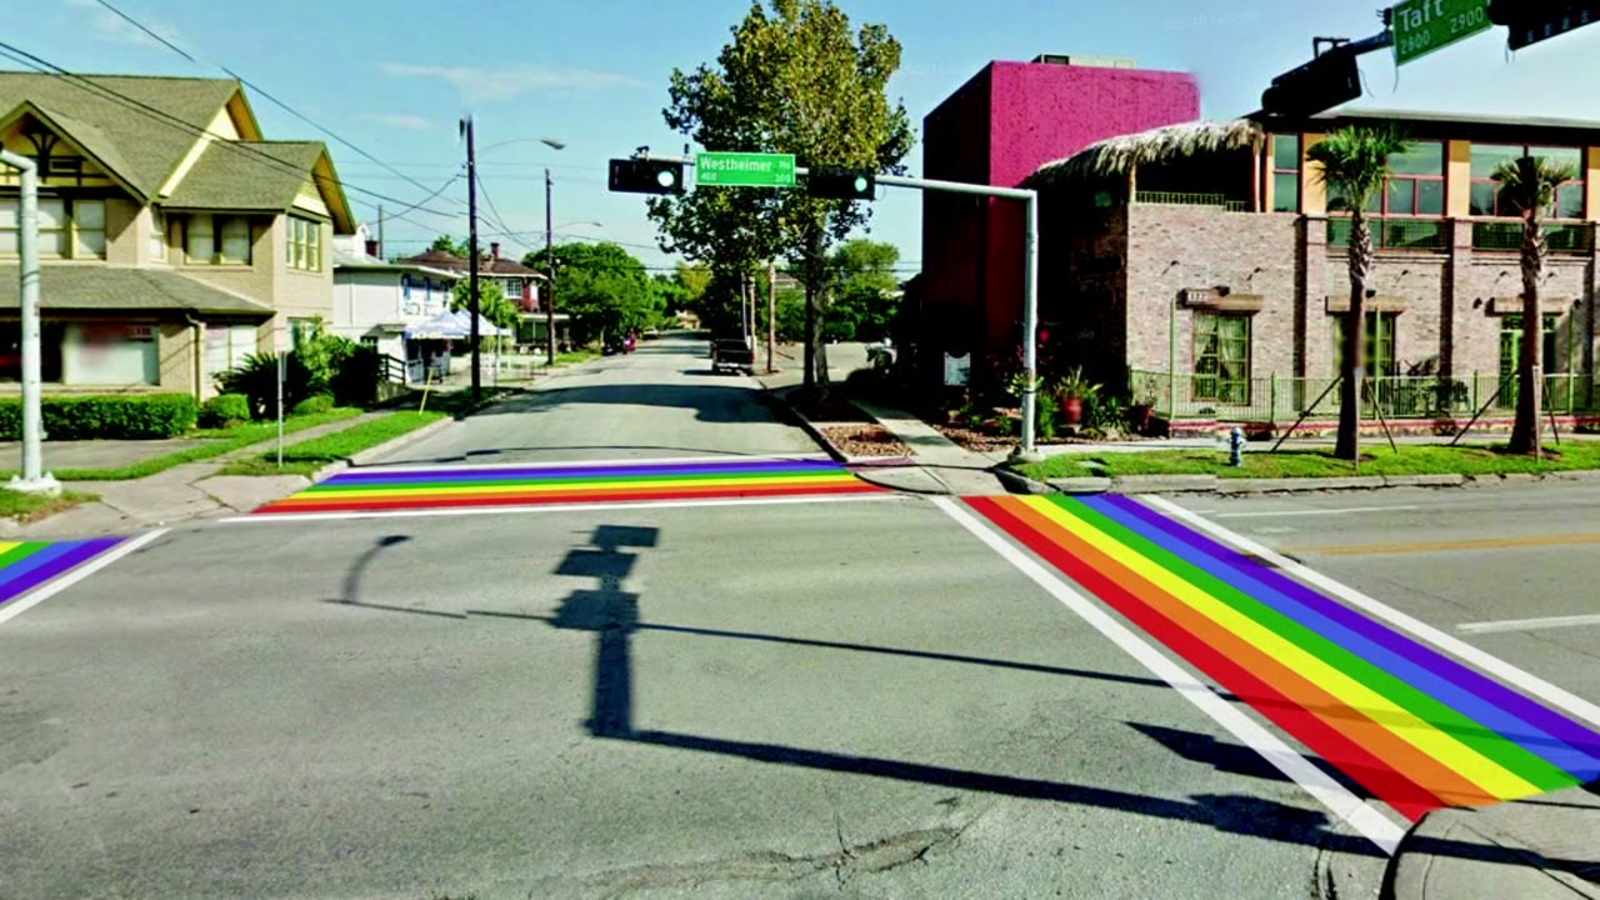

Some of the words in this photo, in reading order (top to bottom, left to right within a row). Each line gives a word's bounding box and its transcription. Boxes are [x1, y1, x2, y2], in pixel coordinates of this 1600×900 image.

[1399, 0, 1443, 31] Taft
[1450, 6, 1485, 33] 2900
[700, 156, 772, 172] Westheimer
